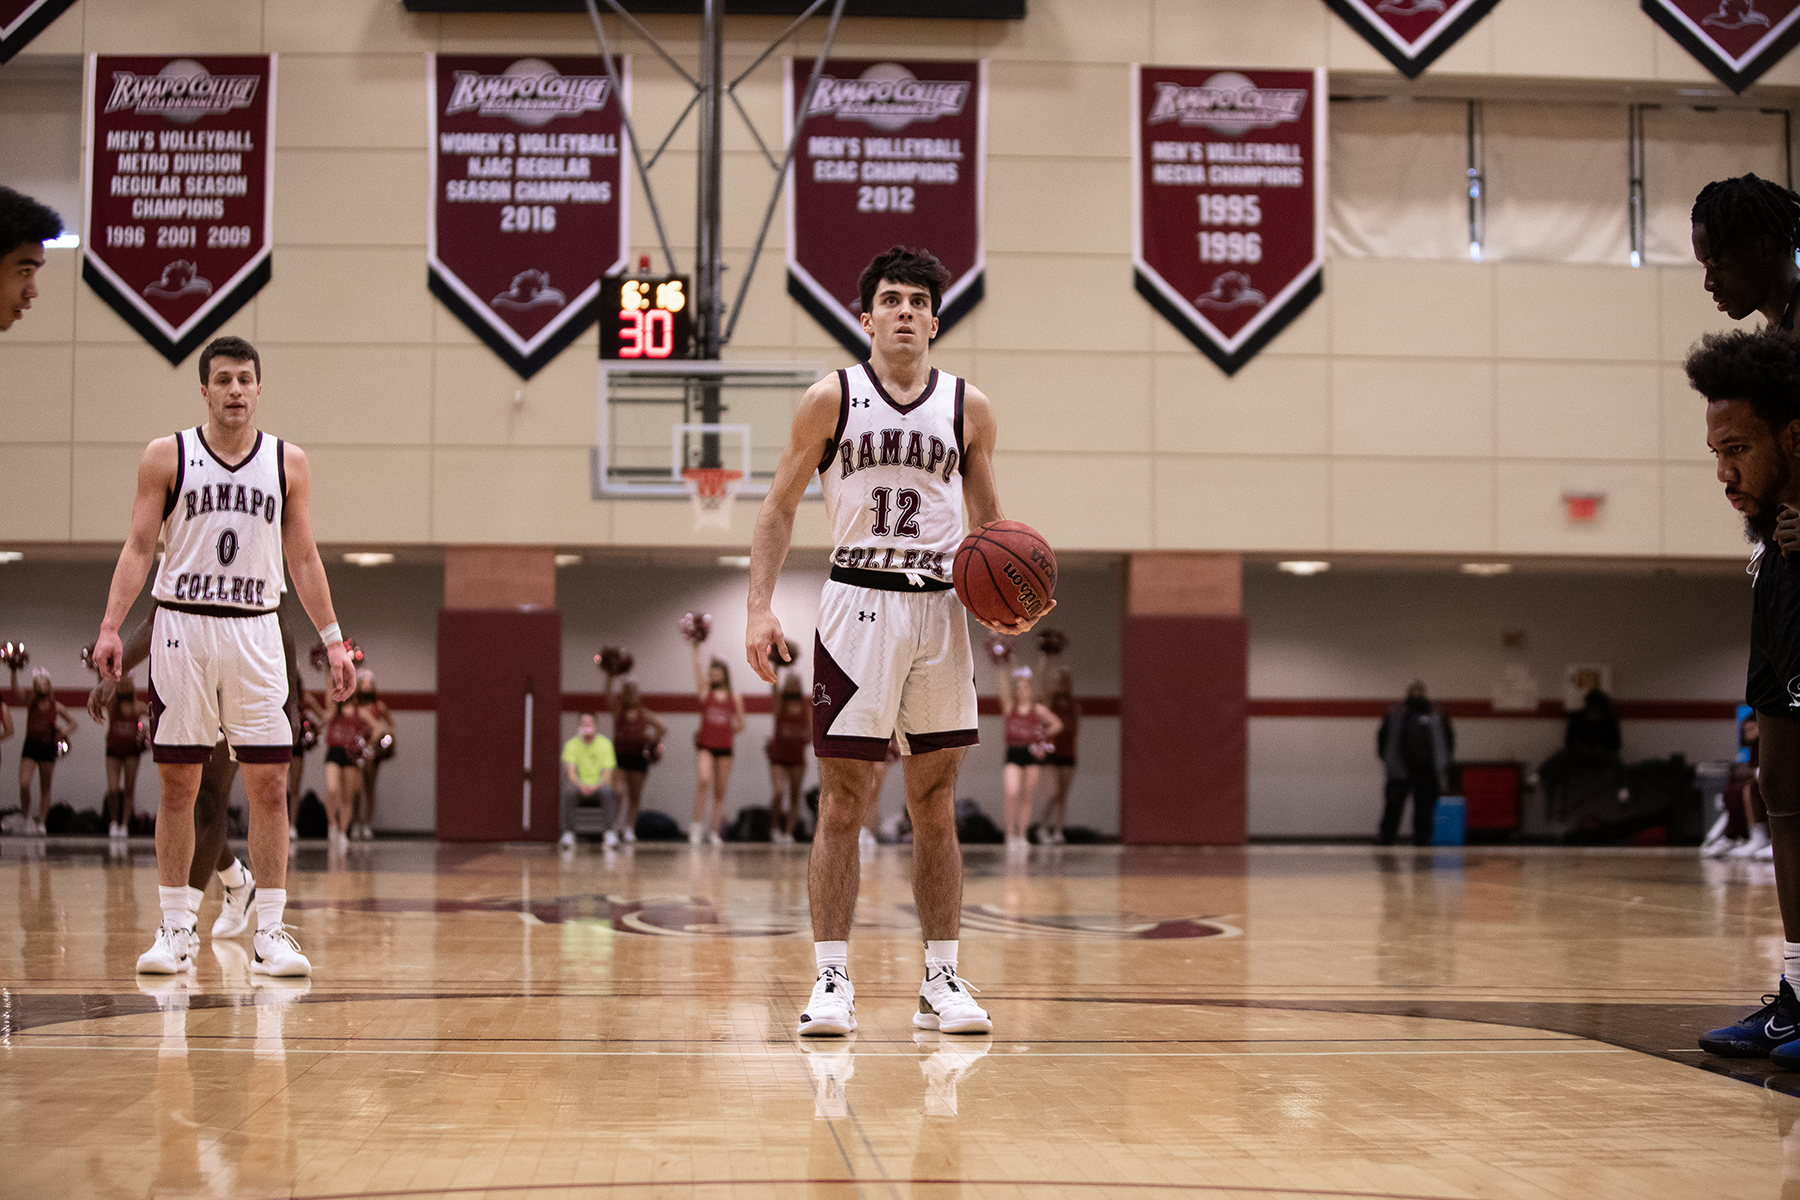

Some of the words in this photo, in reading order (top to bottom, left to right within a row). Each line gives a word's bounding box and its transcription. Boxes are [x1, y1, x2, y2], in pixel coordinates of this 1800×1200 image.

[106, 131, 155, 150] MEN'S
[159, 131, 253, 150] VOLLEYBALL
[440, 133, 515, 154] WOMEN'S
[518, 133, 617, 155] VOLLEYBALL
[808, 136, 861, 158] MEN'S
[863, 137, 963, 160] VOLLEYBALL
[118, 153, 169, 173] METRO
[173, 153, 242, 173] DIVISION
[515, 156, 591, 178] REGULAR
[860, 160, 958, 183] CHAMPIONS
[111, 175, 181, 195] REGULAR
[185, 175, 248, 195] SEASON
[446, 180, 511, 202] SEASON
[514, 180, 611, 202] CHAMPIONS
[132, 198, 224, 218] CHAMPIONS
[857, 185, 915, 213] 2012
[1198, 193, 1262, 226] 1995
[500, 205, 556, 232] 2016
[106, 226, 145, 247] 1996
[157, 226, 197, 247] 2001
[1198, 231, 1262, 263] 1996
[619, 309, 674, 358] 30
[839, 428, 959, 483] RAMAPO
[185, 483, 275, 524] RAMAPO
[870, 486, 921, 538] 12
[215, 527, 240, 566] 0
[175, 572, 265, 606] COLLEGE
